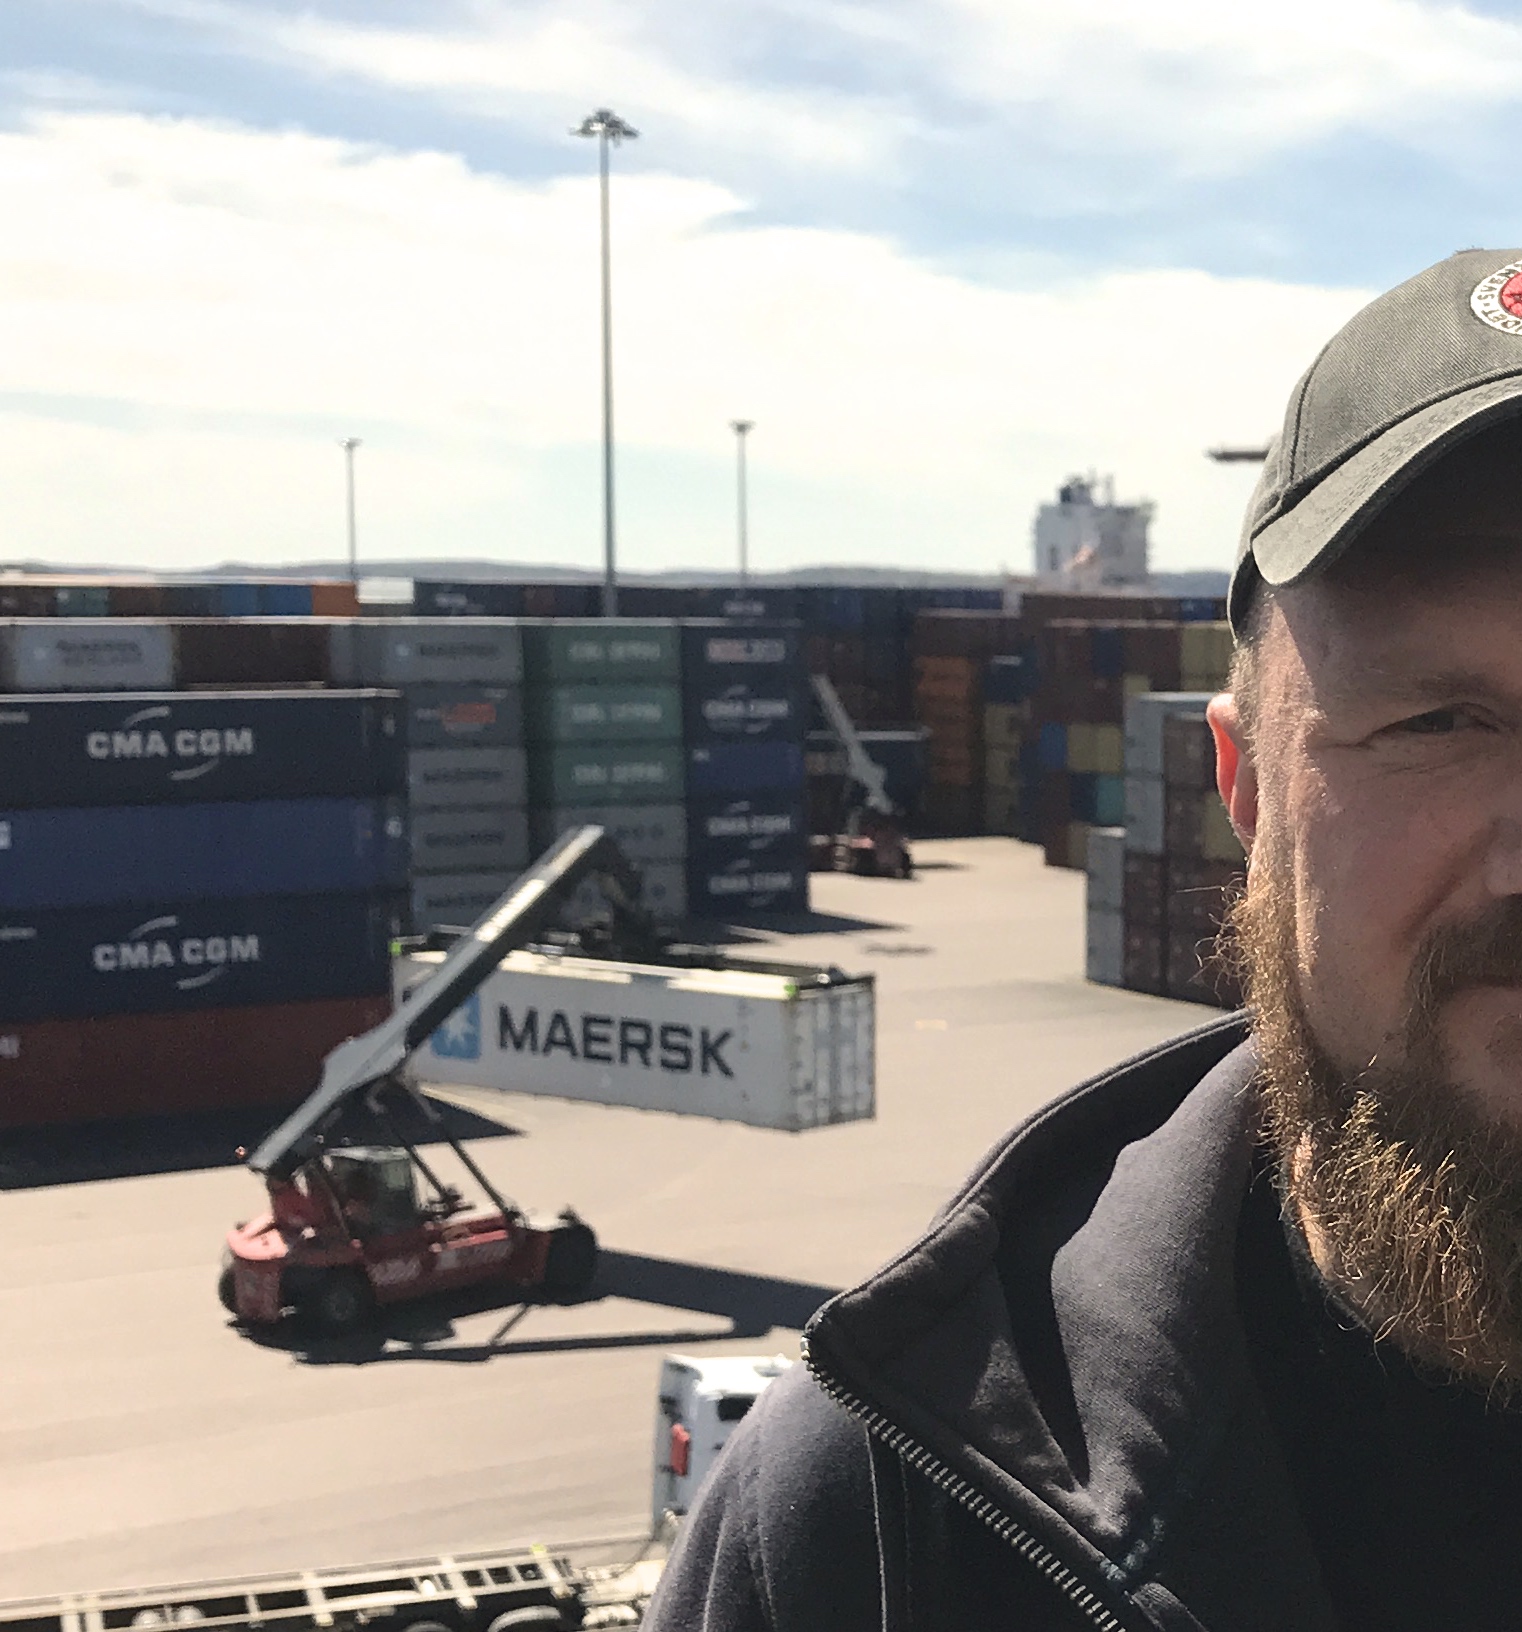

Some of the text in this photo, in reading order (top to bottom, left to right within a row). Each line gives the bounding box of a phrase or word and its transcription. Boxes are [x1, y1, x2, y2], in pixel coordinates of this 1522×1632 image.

[87, 731, 168, 759] CMA
[93, 940, 174, 971] CMA
[496, 1003, 735, 1079] MAERSK
